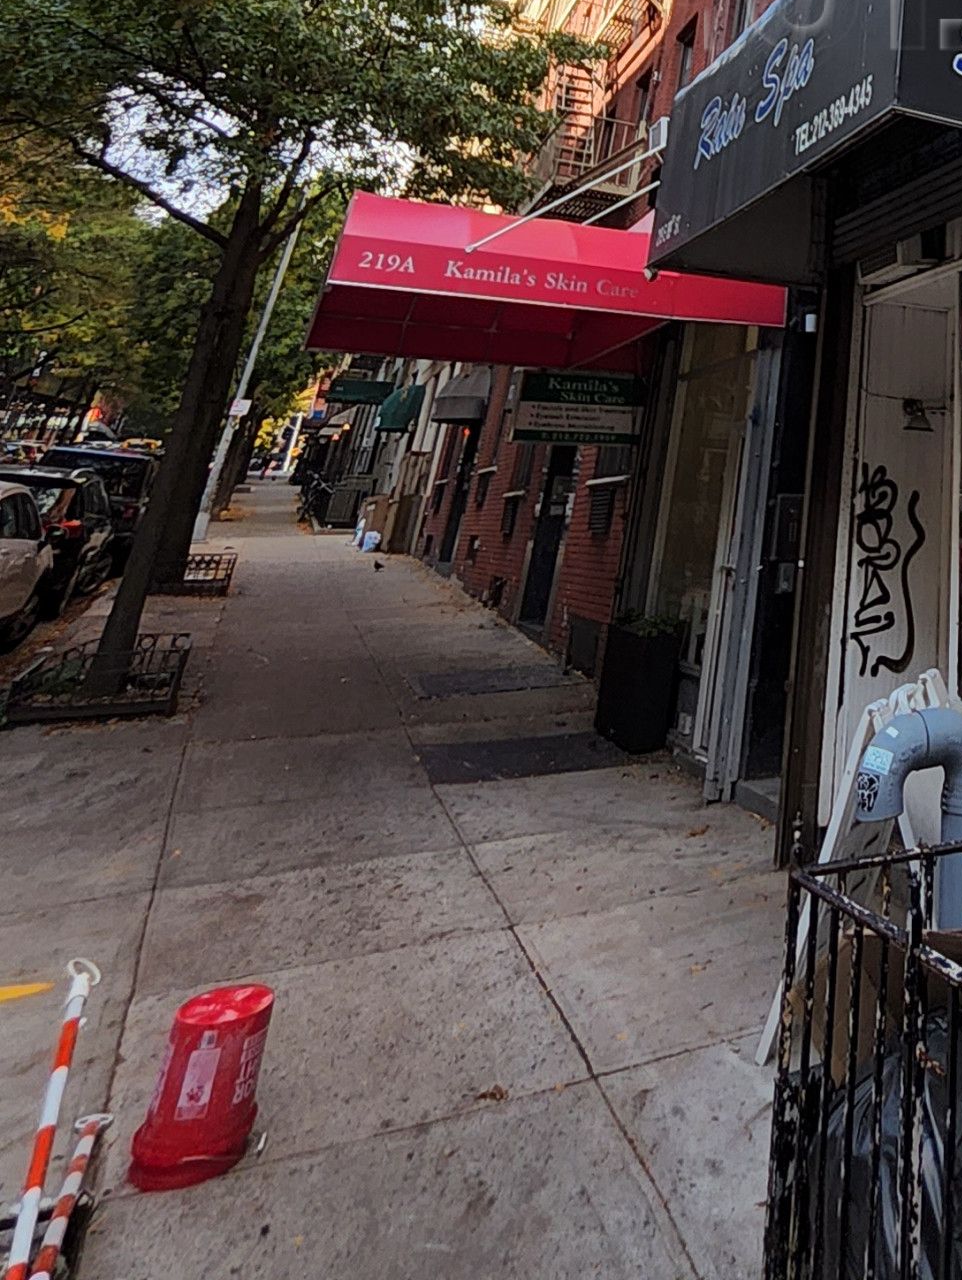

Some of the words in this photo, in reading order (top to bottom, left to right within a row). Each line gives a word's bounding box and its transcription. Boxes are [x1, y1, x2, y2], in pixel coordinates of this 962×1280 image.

[693, 92, 746, 170] Rain
[754, 38, 815, 128] Spa
[358, 251, 416, 273] 219A
[444, 260, 536, 287] Kamila's
[544, 273, 589, 293] Skin
[596, 279, 640, 298] Care
